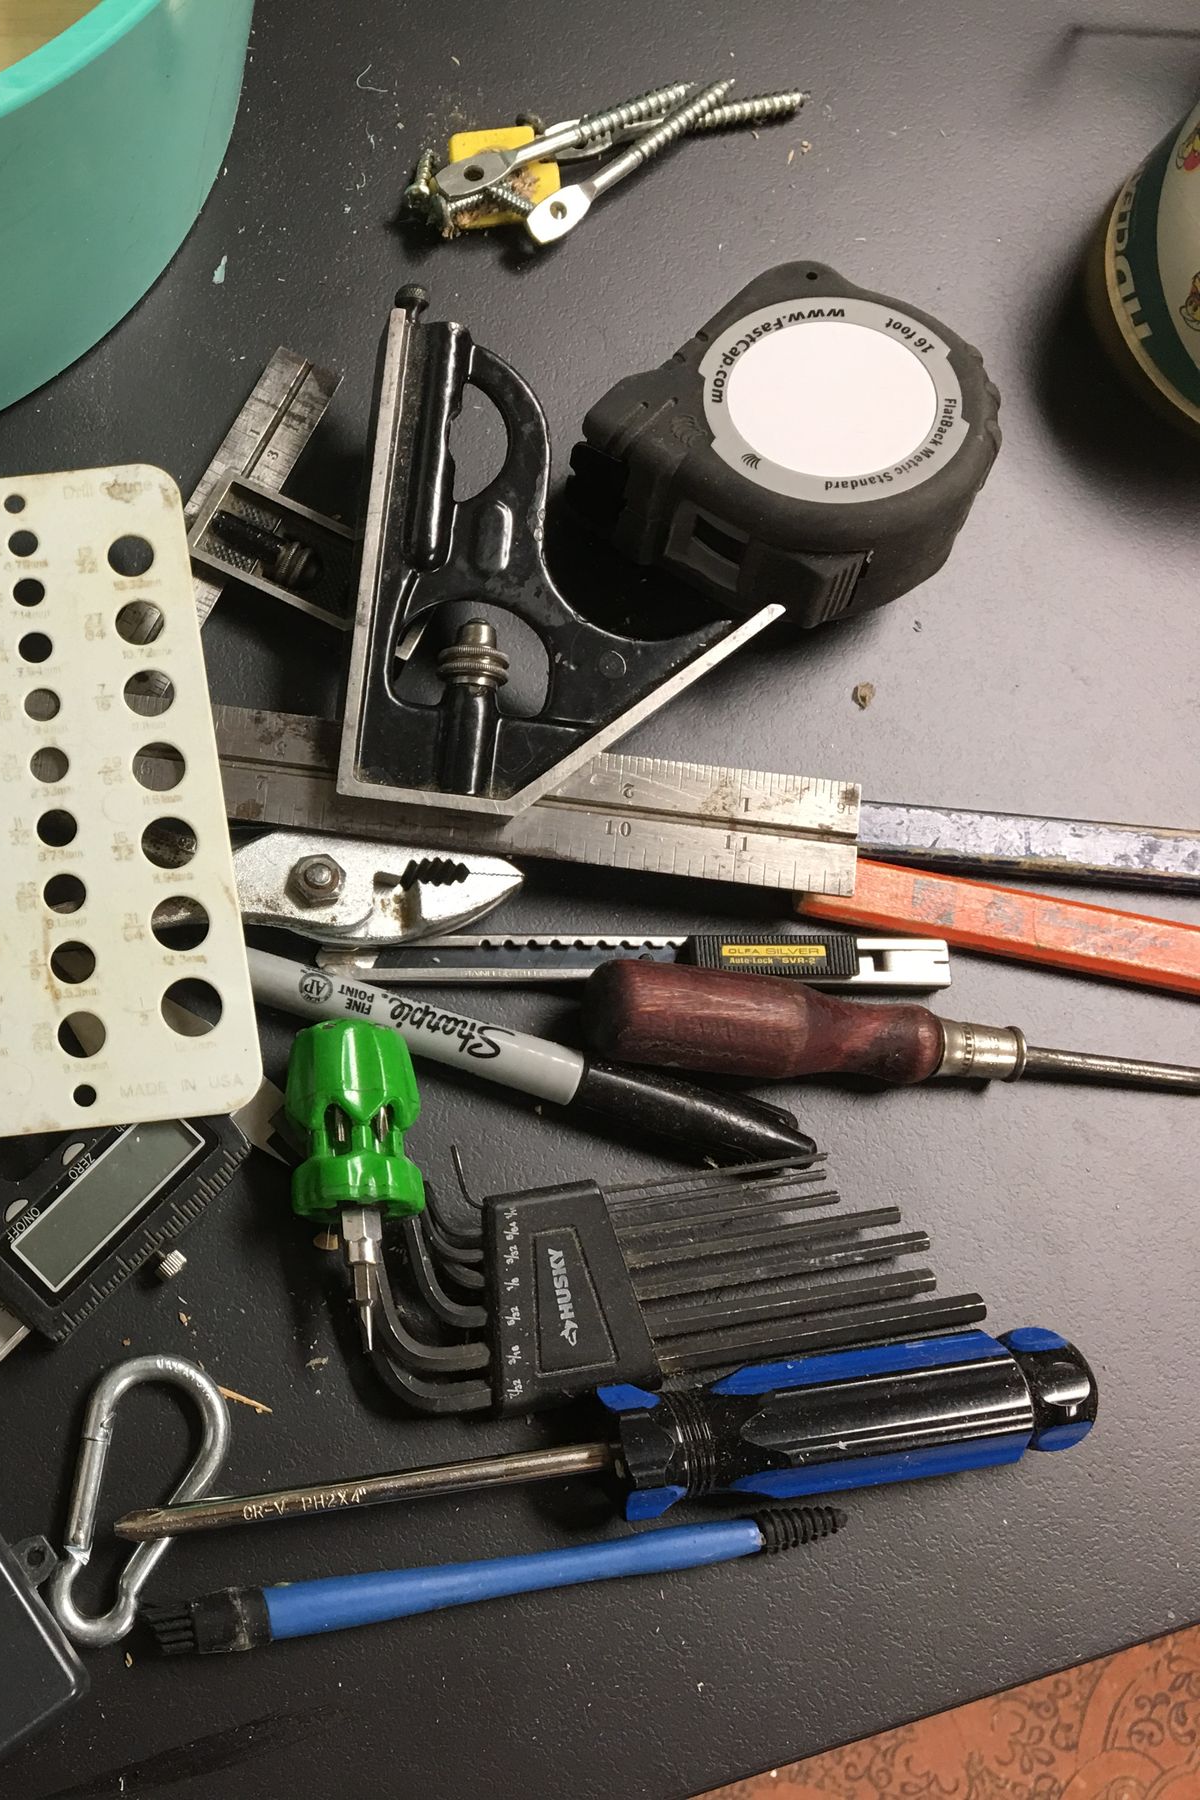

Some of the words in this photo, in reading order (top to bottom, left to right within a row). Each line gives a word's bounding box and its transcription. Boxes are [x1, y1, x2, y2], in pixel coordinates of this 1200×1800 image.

[886, 317, 917, 340] foot
[913, 335, 935, 354] 16
[711, 308, 845, 403] www.FastCap.com
[931, 398, 957, 447] FlatBack
[894, 445, 936, 478] Metric
[63, 481, 93, 500] Drill
[824, 470, 894, 491] Standard
[605, 820, 632, 837] 10
[724, 835, 748, 851] 11
[729, 957, 774, 965] Auto-Lock
[781, 957, 816, 965] SVR-2
[765, 947, 820, 955] SILVER
[304, 979, 327, 996] AP
[338, 984, 375, 1003] POINT
[345, 998, 372, 1015] FINE
[388, 997, 514, 1058] Sharpie
[120, 1082, 167, 1098] MADE
[181, 1079, 197, 1092] IN
[209, 1073, 244, 1089] USA
[68, 1152, 96, 1181] ZERO
[6, 1207, 42, 1243] ON/OFF
[548, 1248, 575, 1320] HUSKY
